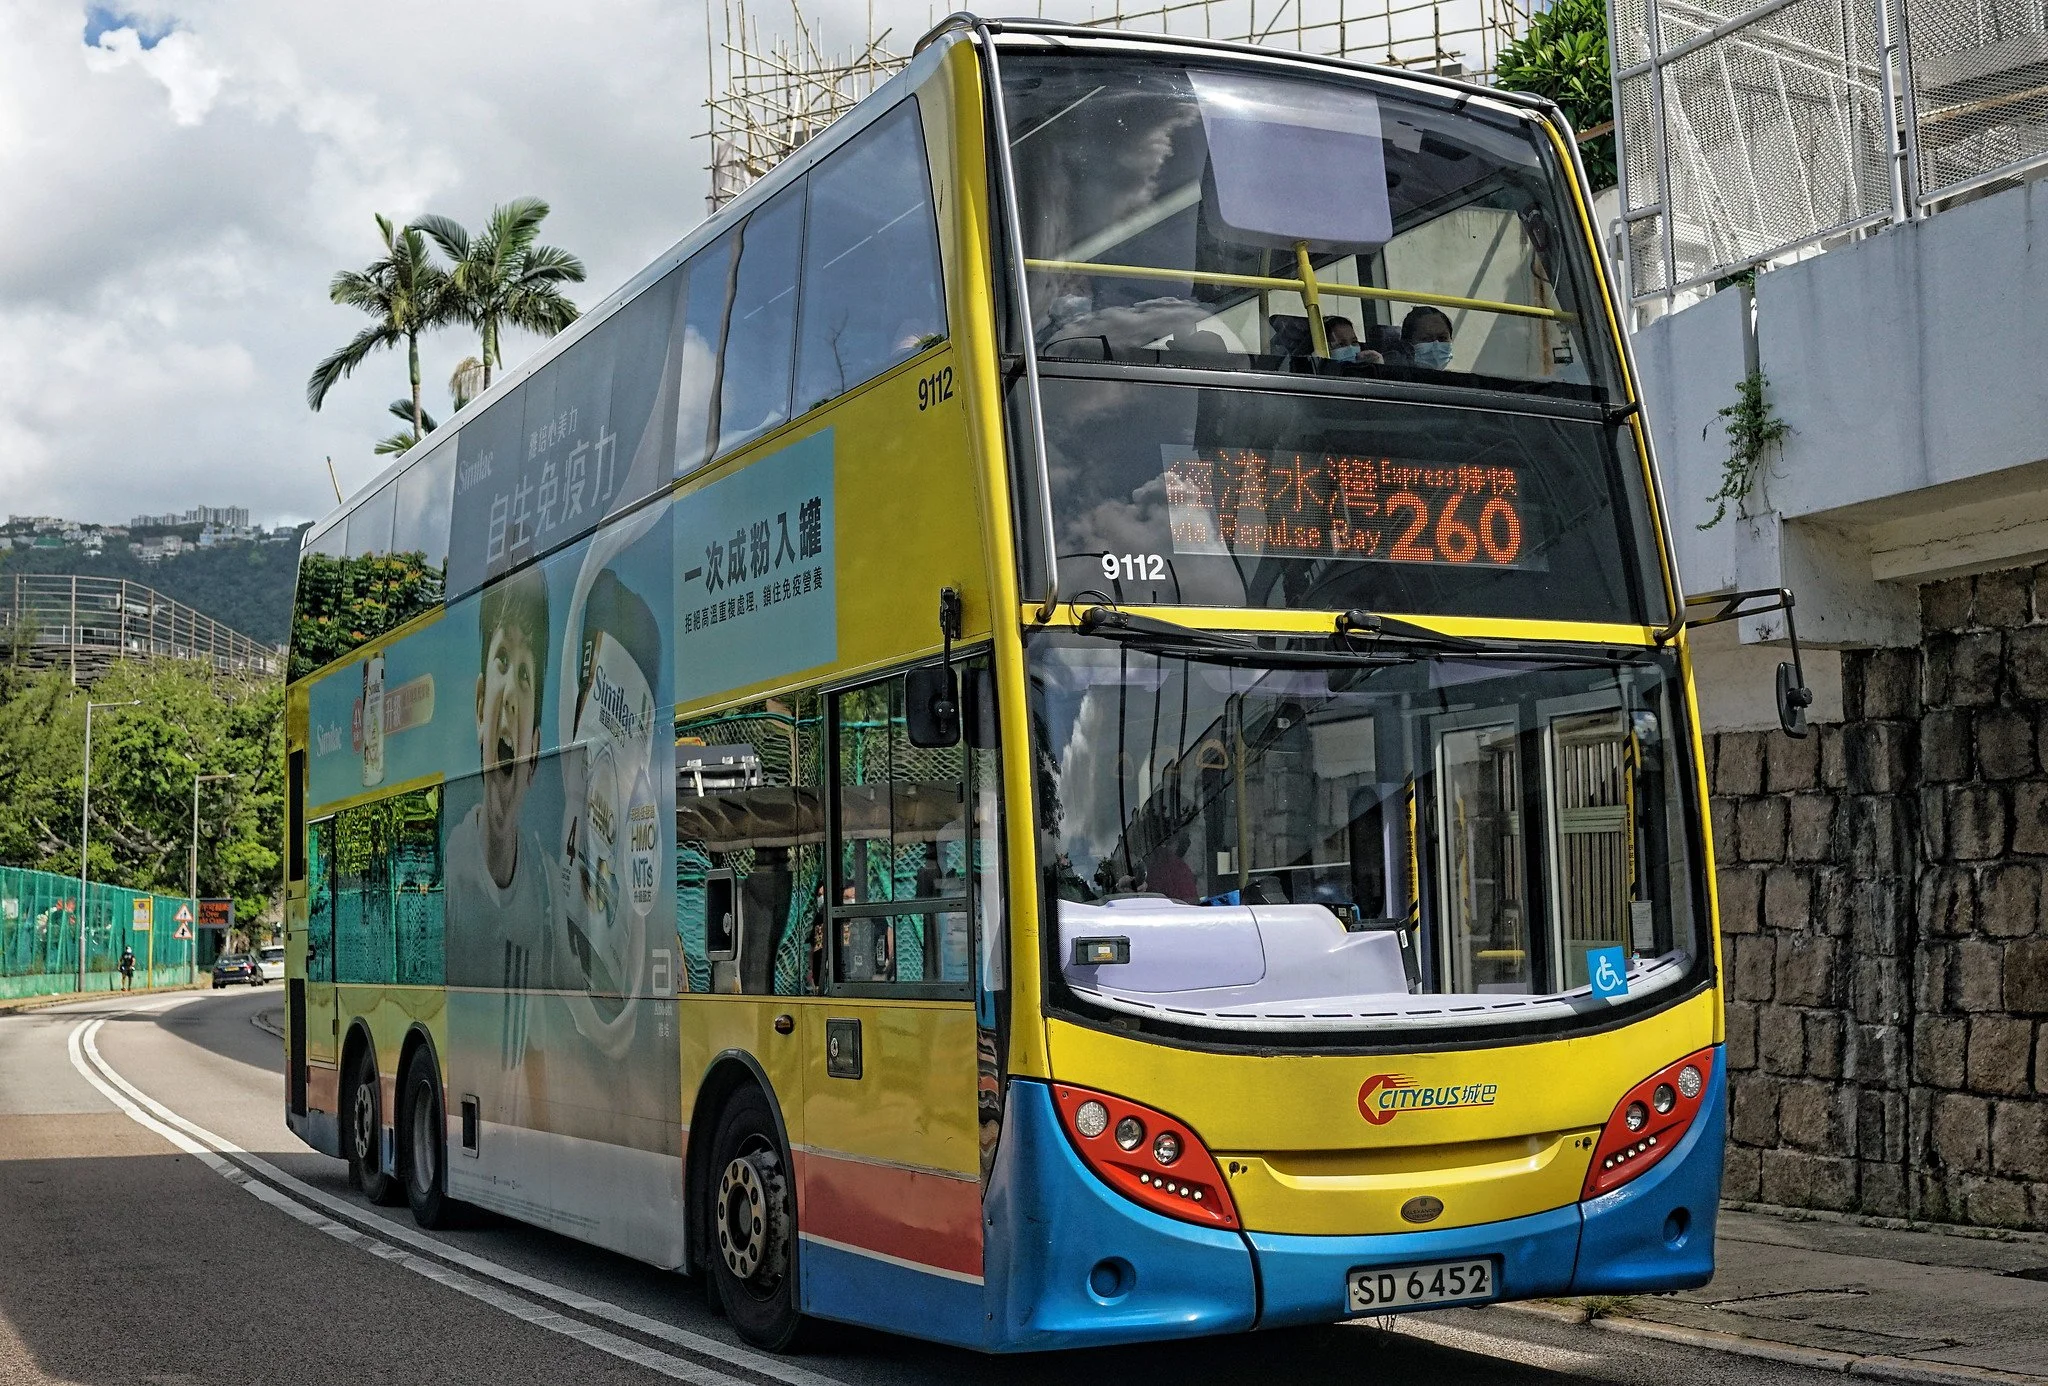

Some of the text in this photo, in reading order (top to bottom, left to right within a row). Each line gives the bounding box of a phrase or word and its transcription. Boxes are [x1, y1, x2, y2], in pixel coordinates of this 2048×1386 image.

[918, 365, 953, 411] 9112
[457, 449, 494, 495] Similac
[487, 424, 617, 565] 自生免疫力
[1167, 450, 1379, 516] 經淺水灣
[1381, 460, 1453, 490] Express
[684, 496, 822, 595] 一次成粉入罐
[1169, 512, 1381, 556] via Repulse Bay
[1385, 492, 1522, 565] 260
[1102, 553, 1167, 580] 9112
[593, 665, 635, 739] Similac
[631, 823, 656, 852] HMO
[633, 857, 653, 888] NTs
[1378, 1083, 1498, 1110] CITYBUS 城巴
[1357, 1264, 1487, 1305] SD 6452
